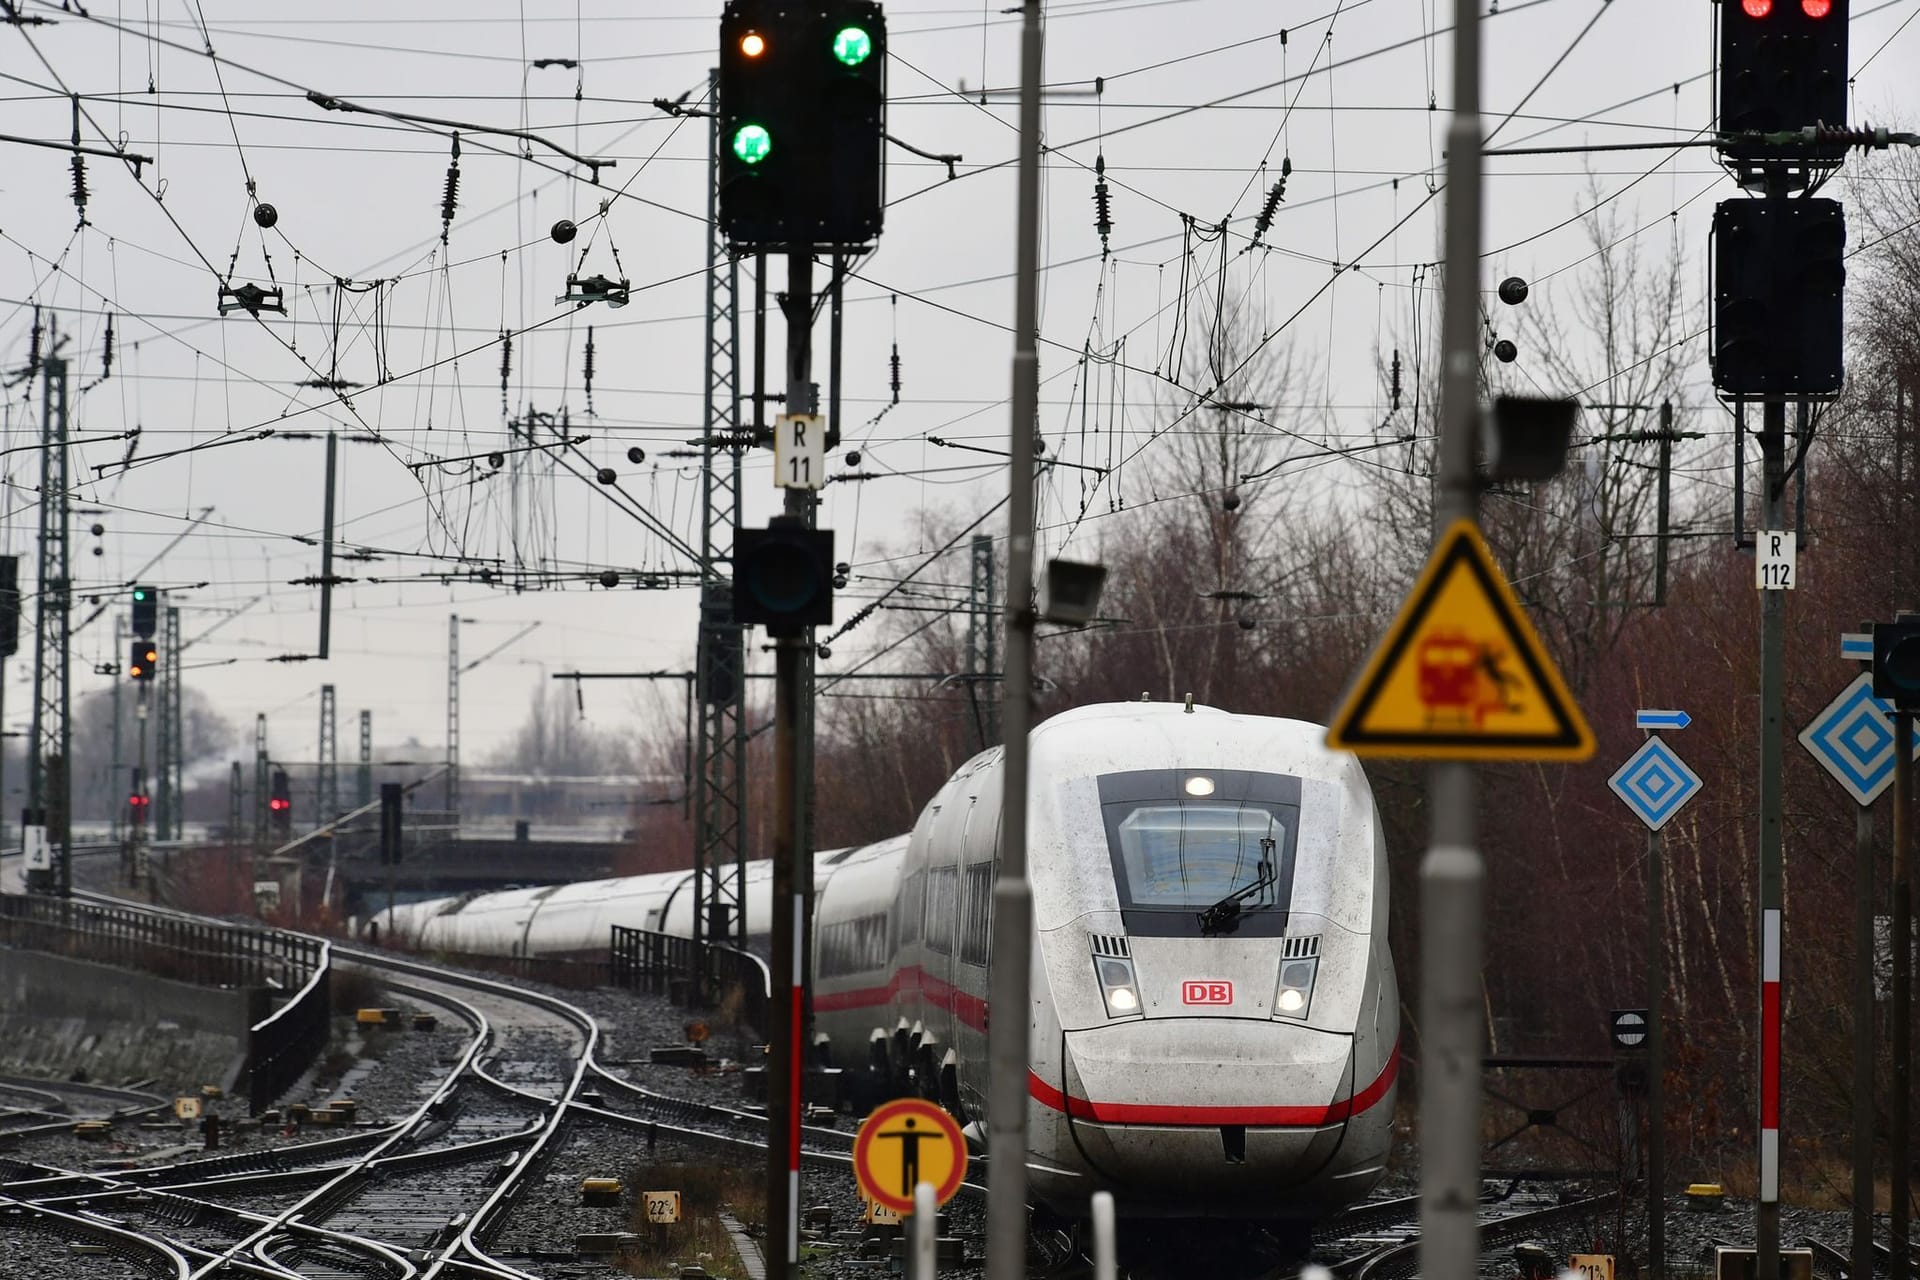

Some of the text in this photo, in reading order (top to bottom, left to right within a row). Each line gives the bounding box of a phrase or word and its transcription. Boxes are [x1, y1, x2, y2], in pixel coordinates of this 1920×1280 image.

[793, 421, 806, 447] R
[789, 456, 810, 483] 11
[1771, 535, 1781, 557] R
[1761, 563, 1790, 585] 112
[1188, 984, 1228, 1001] DB
